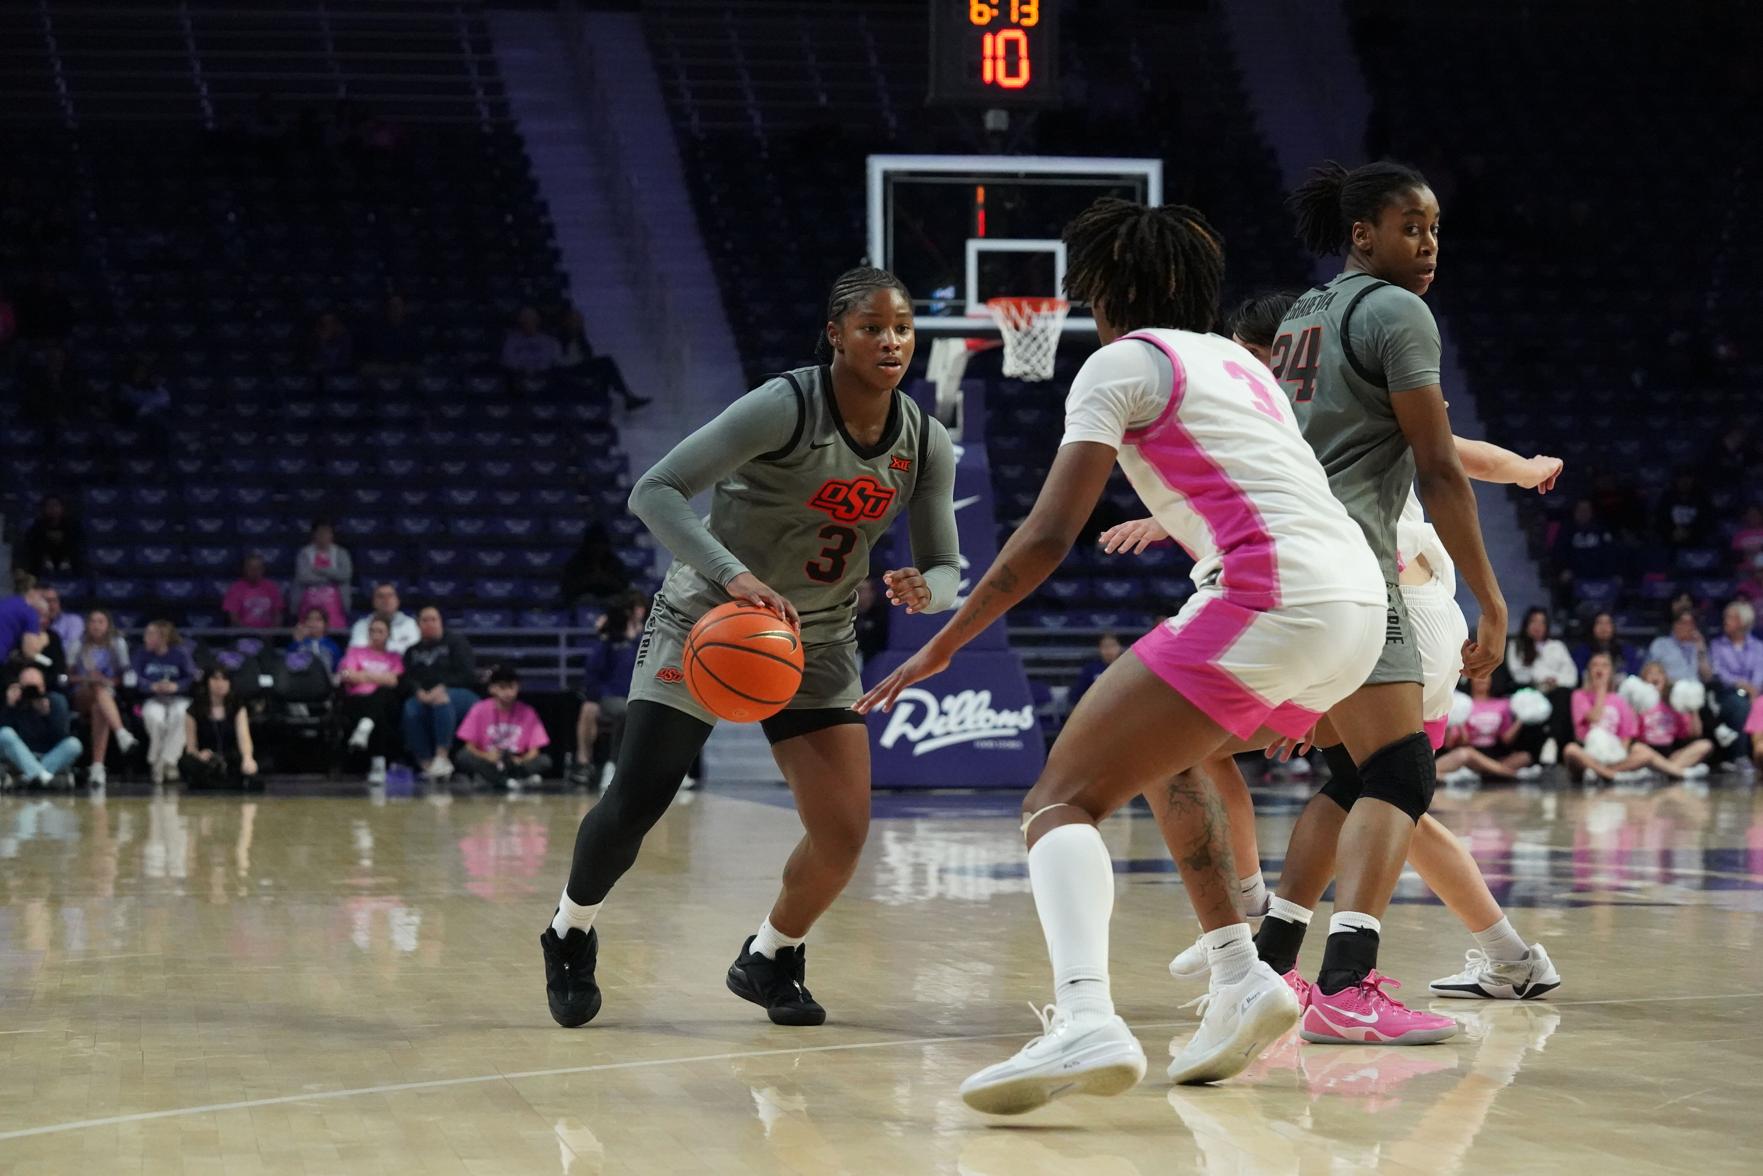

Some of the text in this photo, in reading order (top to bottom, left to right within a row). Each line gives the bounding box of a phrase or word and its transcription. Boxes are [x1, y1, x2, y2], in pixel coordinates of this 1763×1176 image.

[983, 28, 1030, 88] 10
[1222, 359, 1285, 425] 3
[1271, 327, 1321, 401] 24
[806, 477, 896, 523] OSU
[804, 524, 857, 583] 3
[873, 688, 1034, 749] Dillons
